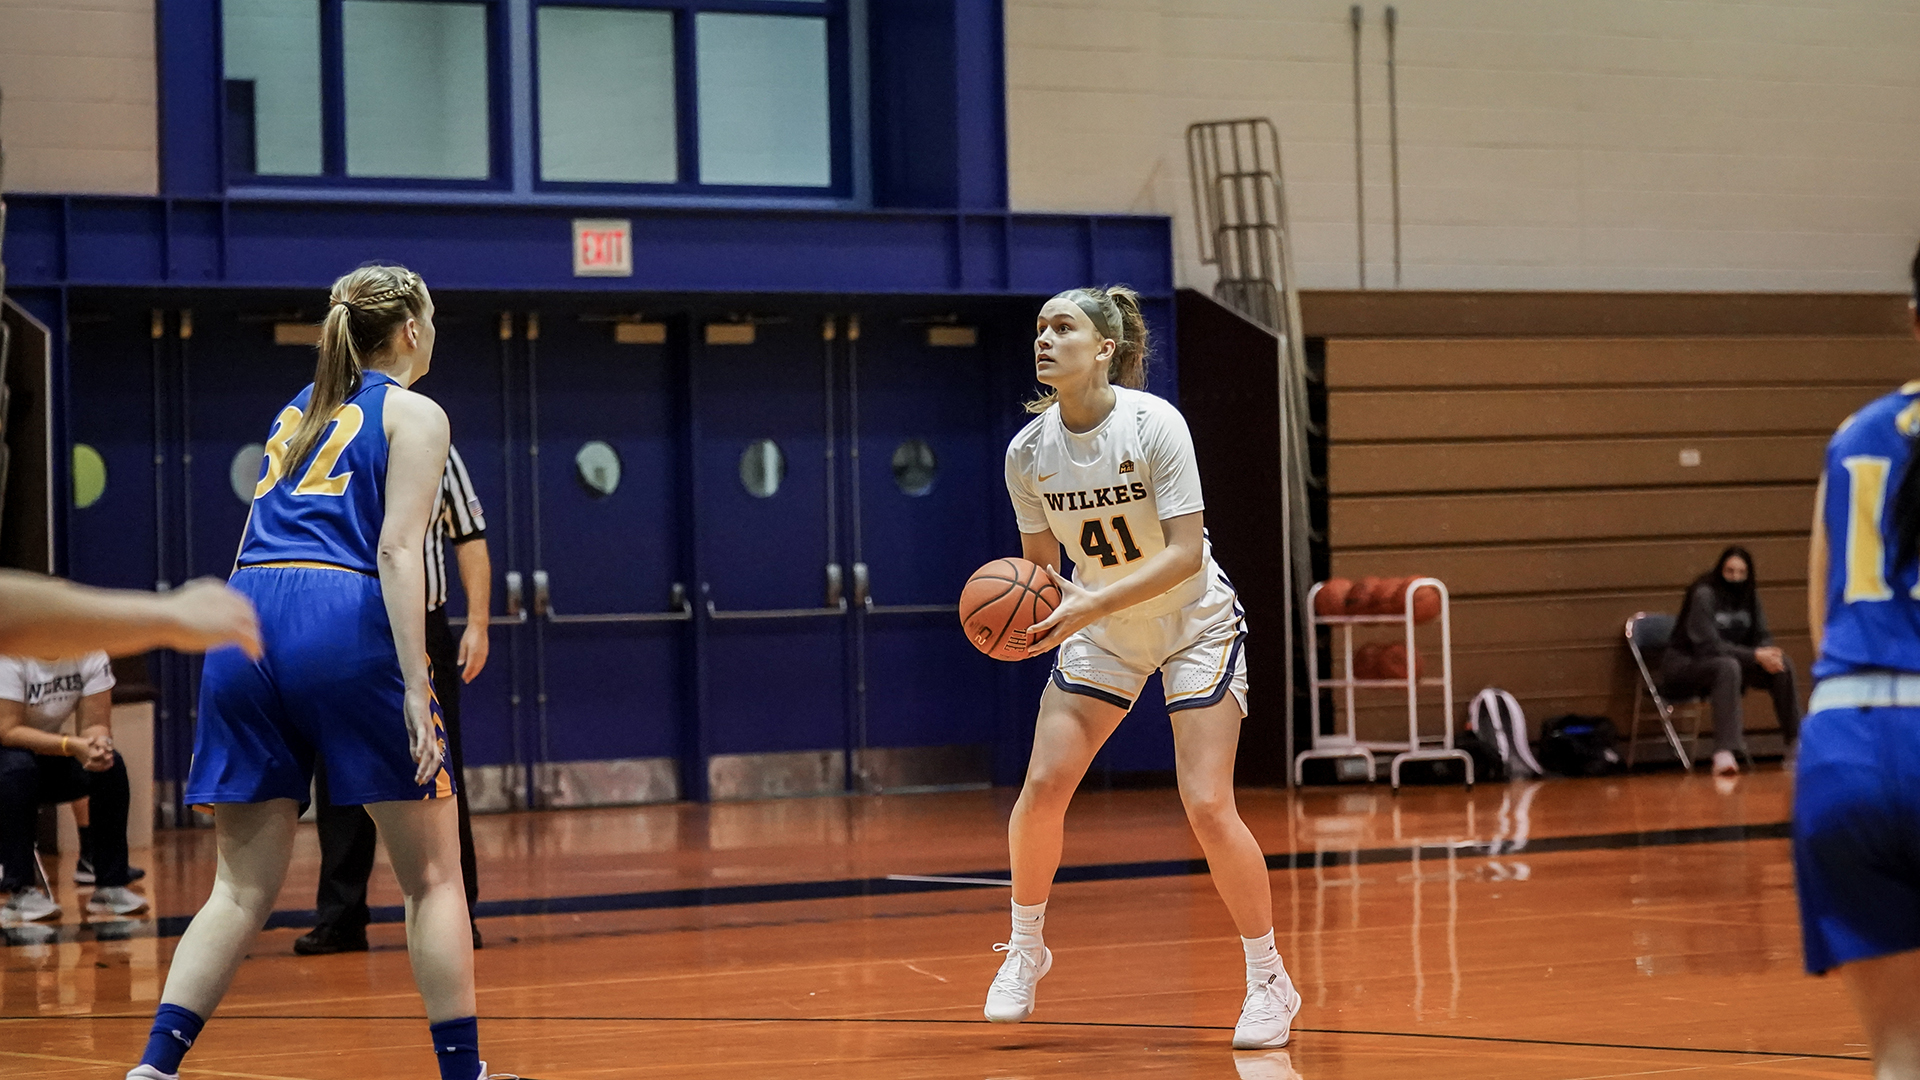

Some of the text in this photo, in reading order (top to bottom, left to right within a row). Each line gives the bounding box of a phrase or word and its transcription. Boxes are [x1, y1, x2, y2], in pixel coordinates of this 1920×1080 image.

[582, 230, 624, 265] EXIT
[254, 403, 364, 499] 32
[1043, 482, 1147, 511] WILKES
[1079, 514, 1144, 569] 41
[1842, 455, 1920, 603] 1
[1003, 628, 1027, 652] THE
